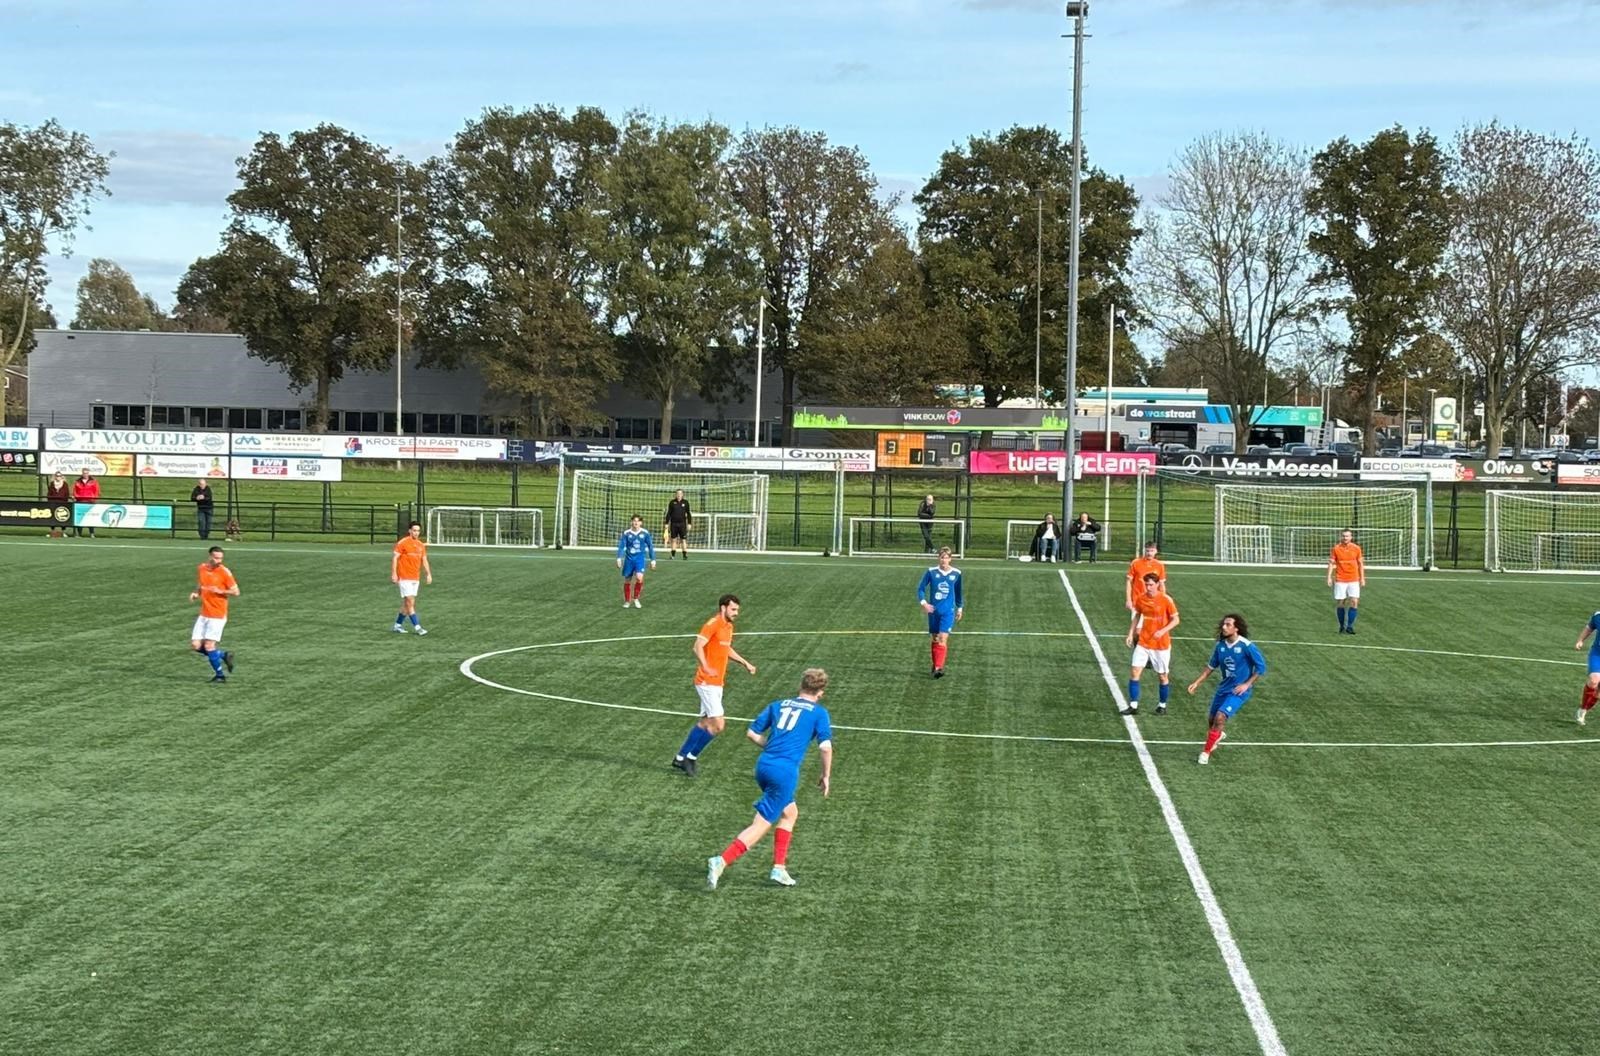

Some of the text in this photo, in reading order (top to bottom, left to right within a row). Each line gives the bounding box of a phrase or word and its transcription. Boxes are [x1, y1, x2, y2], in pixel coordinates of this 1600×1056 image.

[903, 413, 946, 421] VINK BOUW
[1130, 408, 1196, 419] de wasstraat
[12, 431, 28, 441] BV
[102, 432, 196, 446] WOUTJE
[366, 438, 492, 448] KROES EN PARTNERS
[888, 441, 896, 454] 3
[951, 442, 961, 455] 0
[257, 458, 283, 466] TWIN
[1221, 457, 1260, 476] Van
[1483, 460, 1524, 474] Oliva
[256, 467, 283, 475] SPORT
[777, 707, 803, 731] 11
